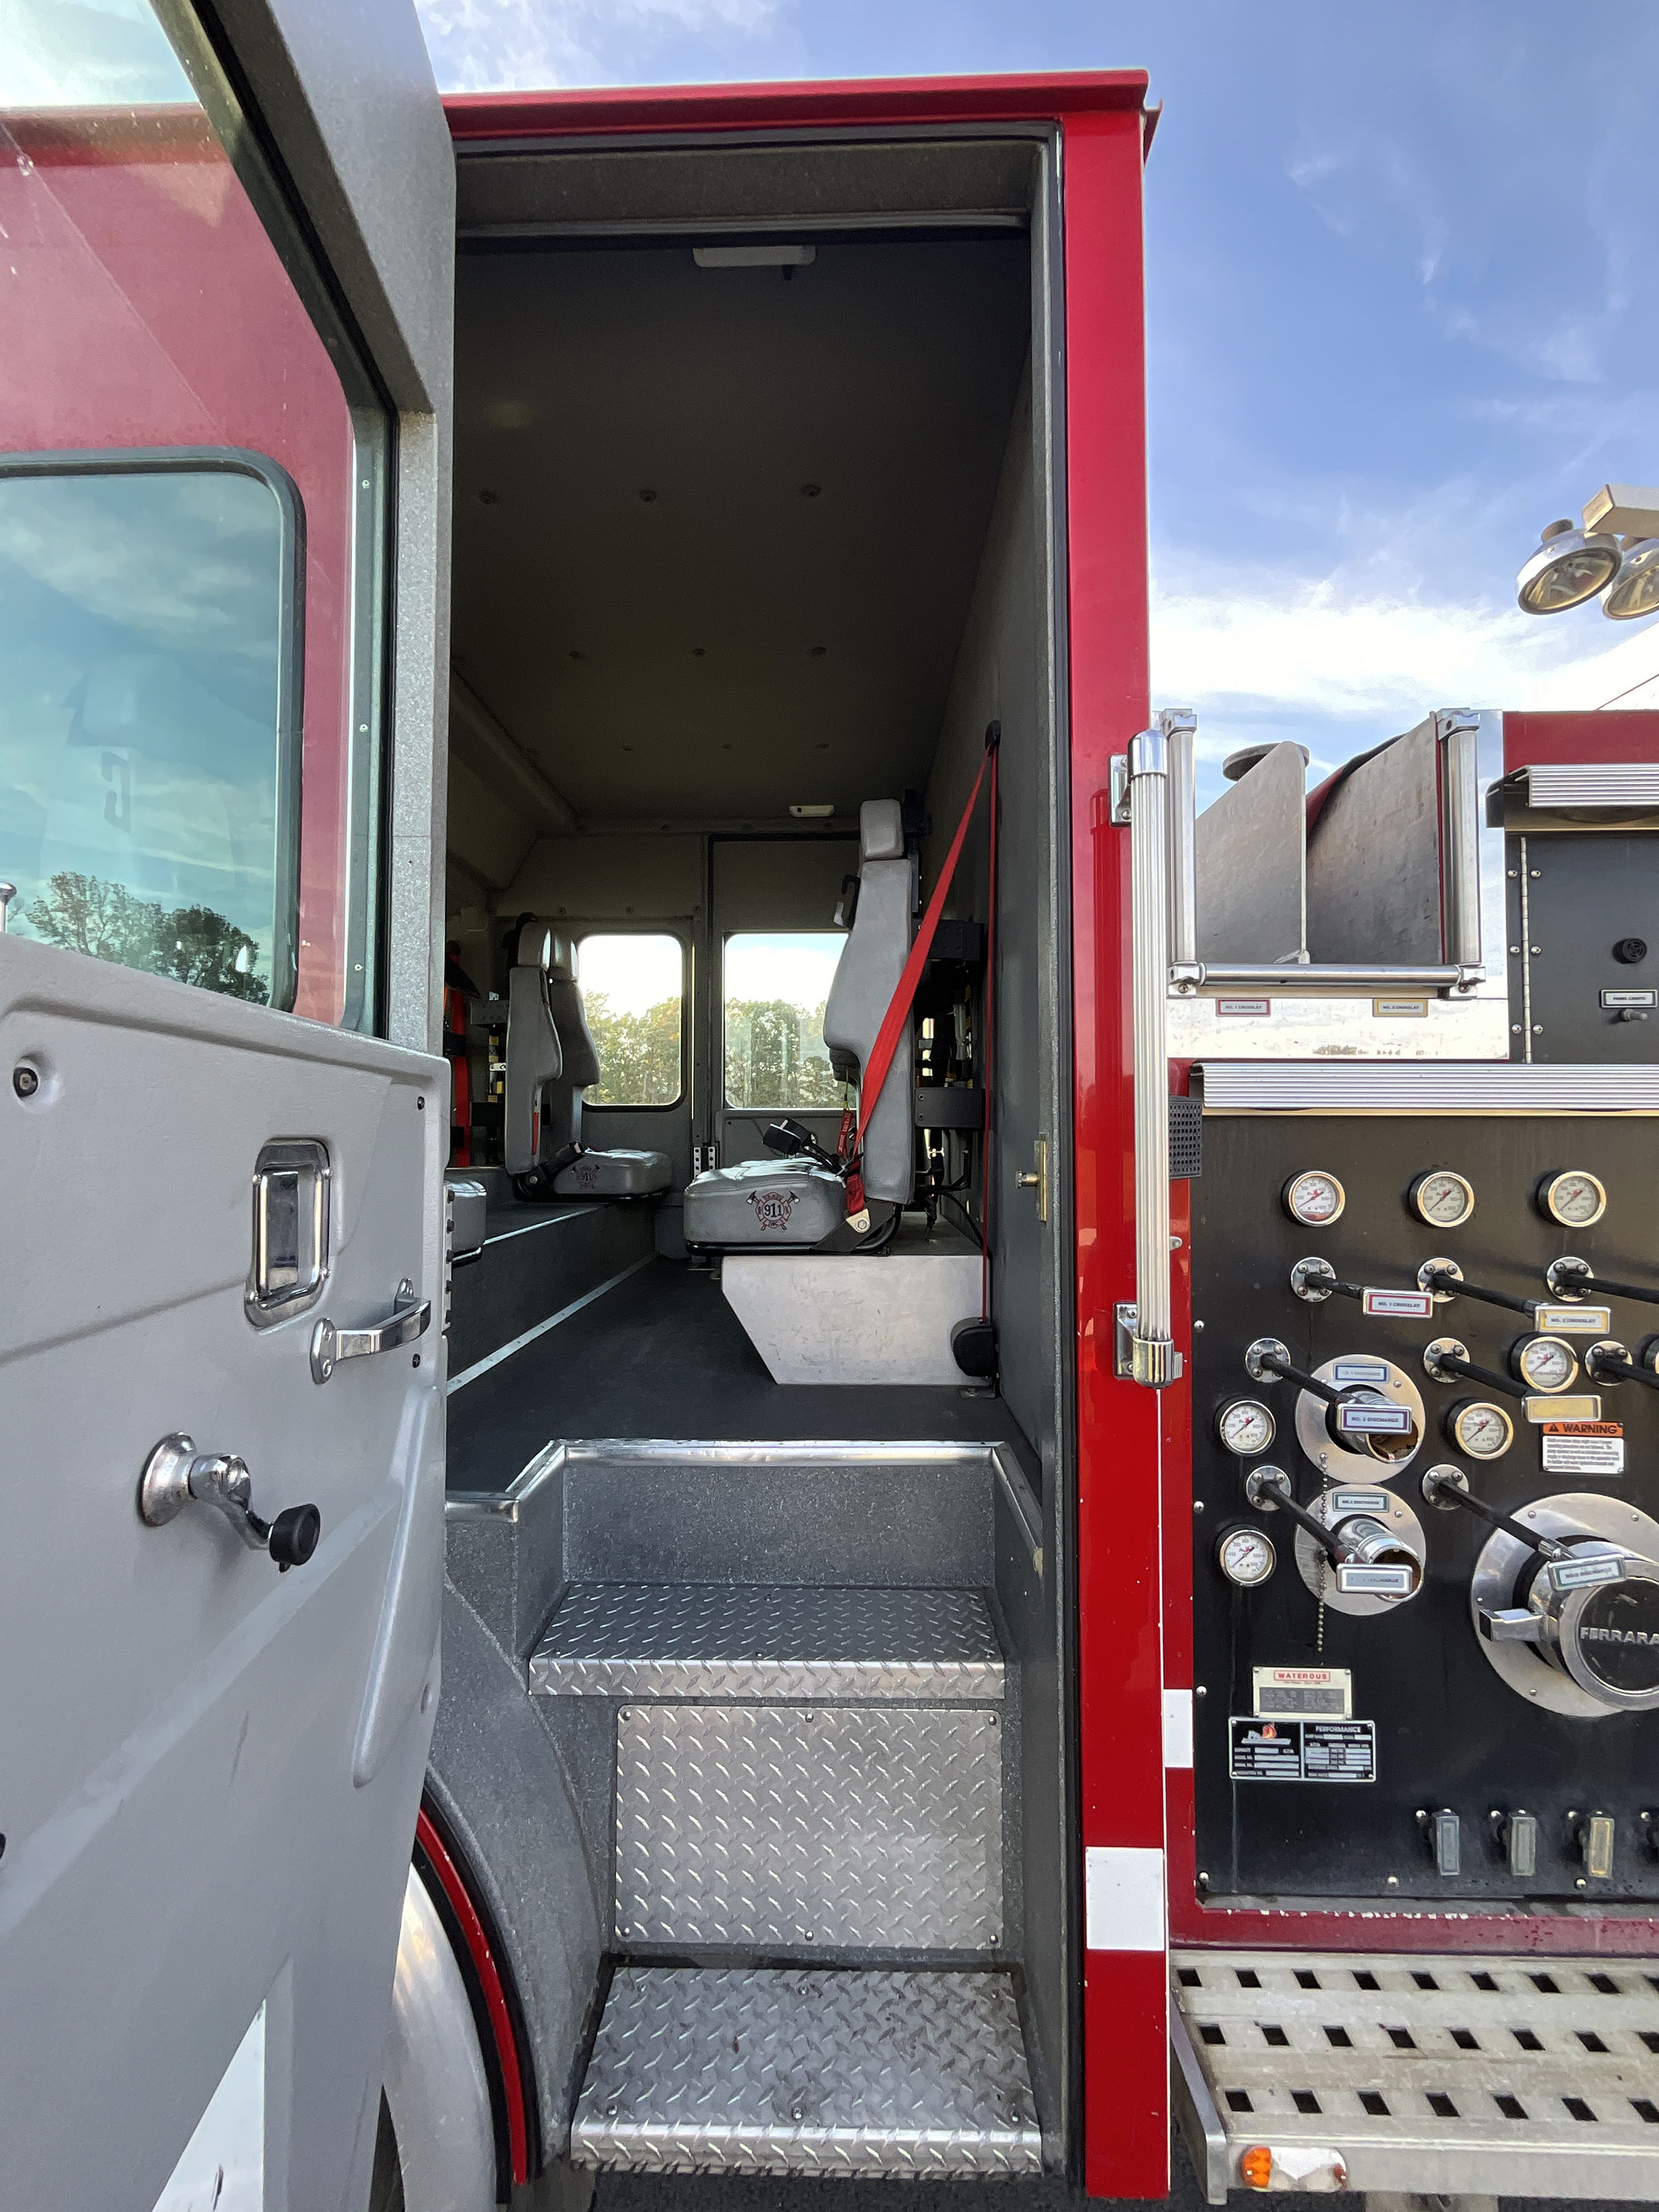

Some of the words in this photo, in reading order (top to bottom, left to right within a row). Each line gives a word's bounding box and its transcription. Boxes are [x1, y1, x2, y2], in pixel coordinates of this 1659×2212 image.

[765, 1203, 783, 1217] 911
[1563, 1424, 1618, 1434] WARNING
[1580, 1627, 1659, 1645] FERRARA
